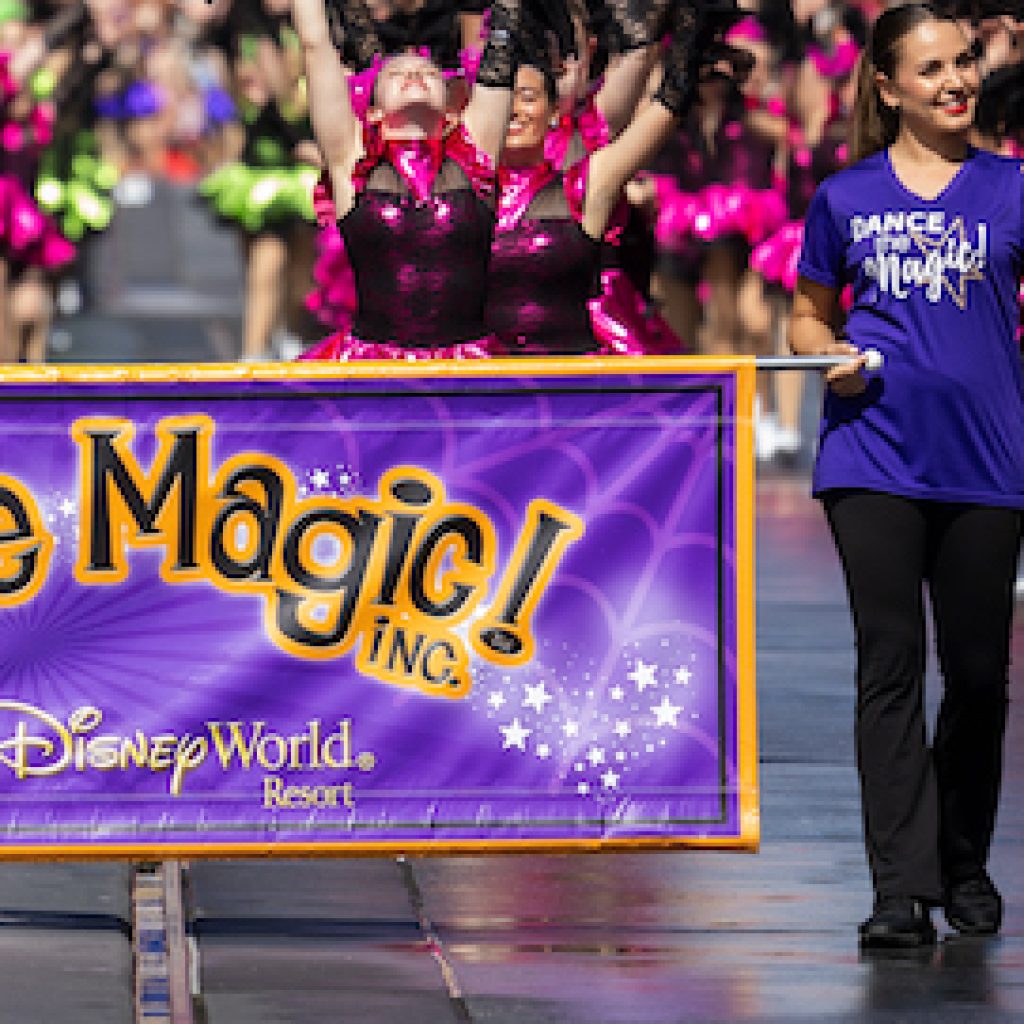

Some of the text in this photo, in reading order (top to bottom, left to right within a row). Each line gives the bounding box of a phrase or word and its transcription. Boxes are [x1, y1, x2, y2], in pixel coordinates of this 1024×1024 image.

[850, 211, 945, 242] DANCE
[861, 223, 987, 302] Magic!
[79, 425, 575, 656] Magic!
[262, 777, 355, 809] Resort
